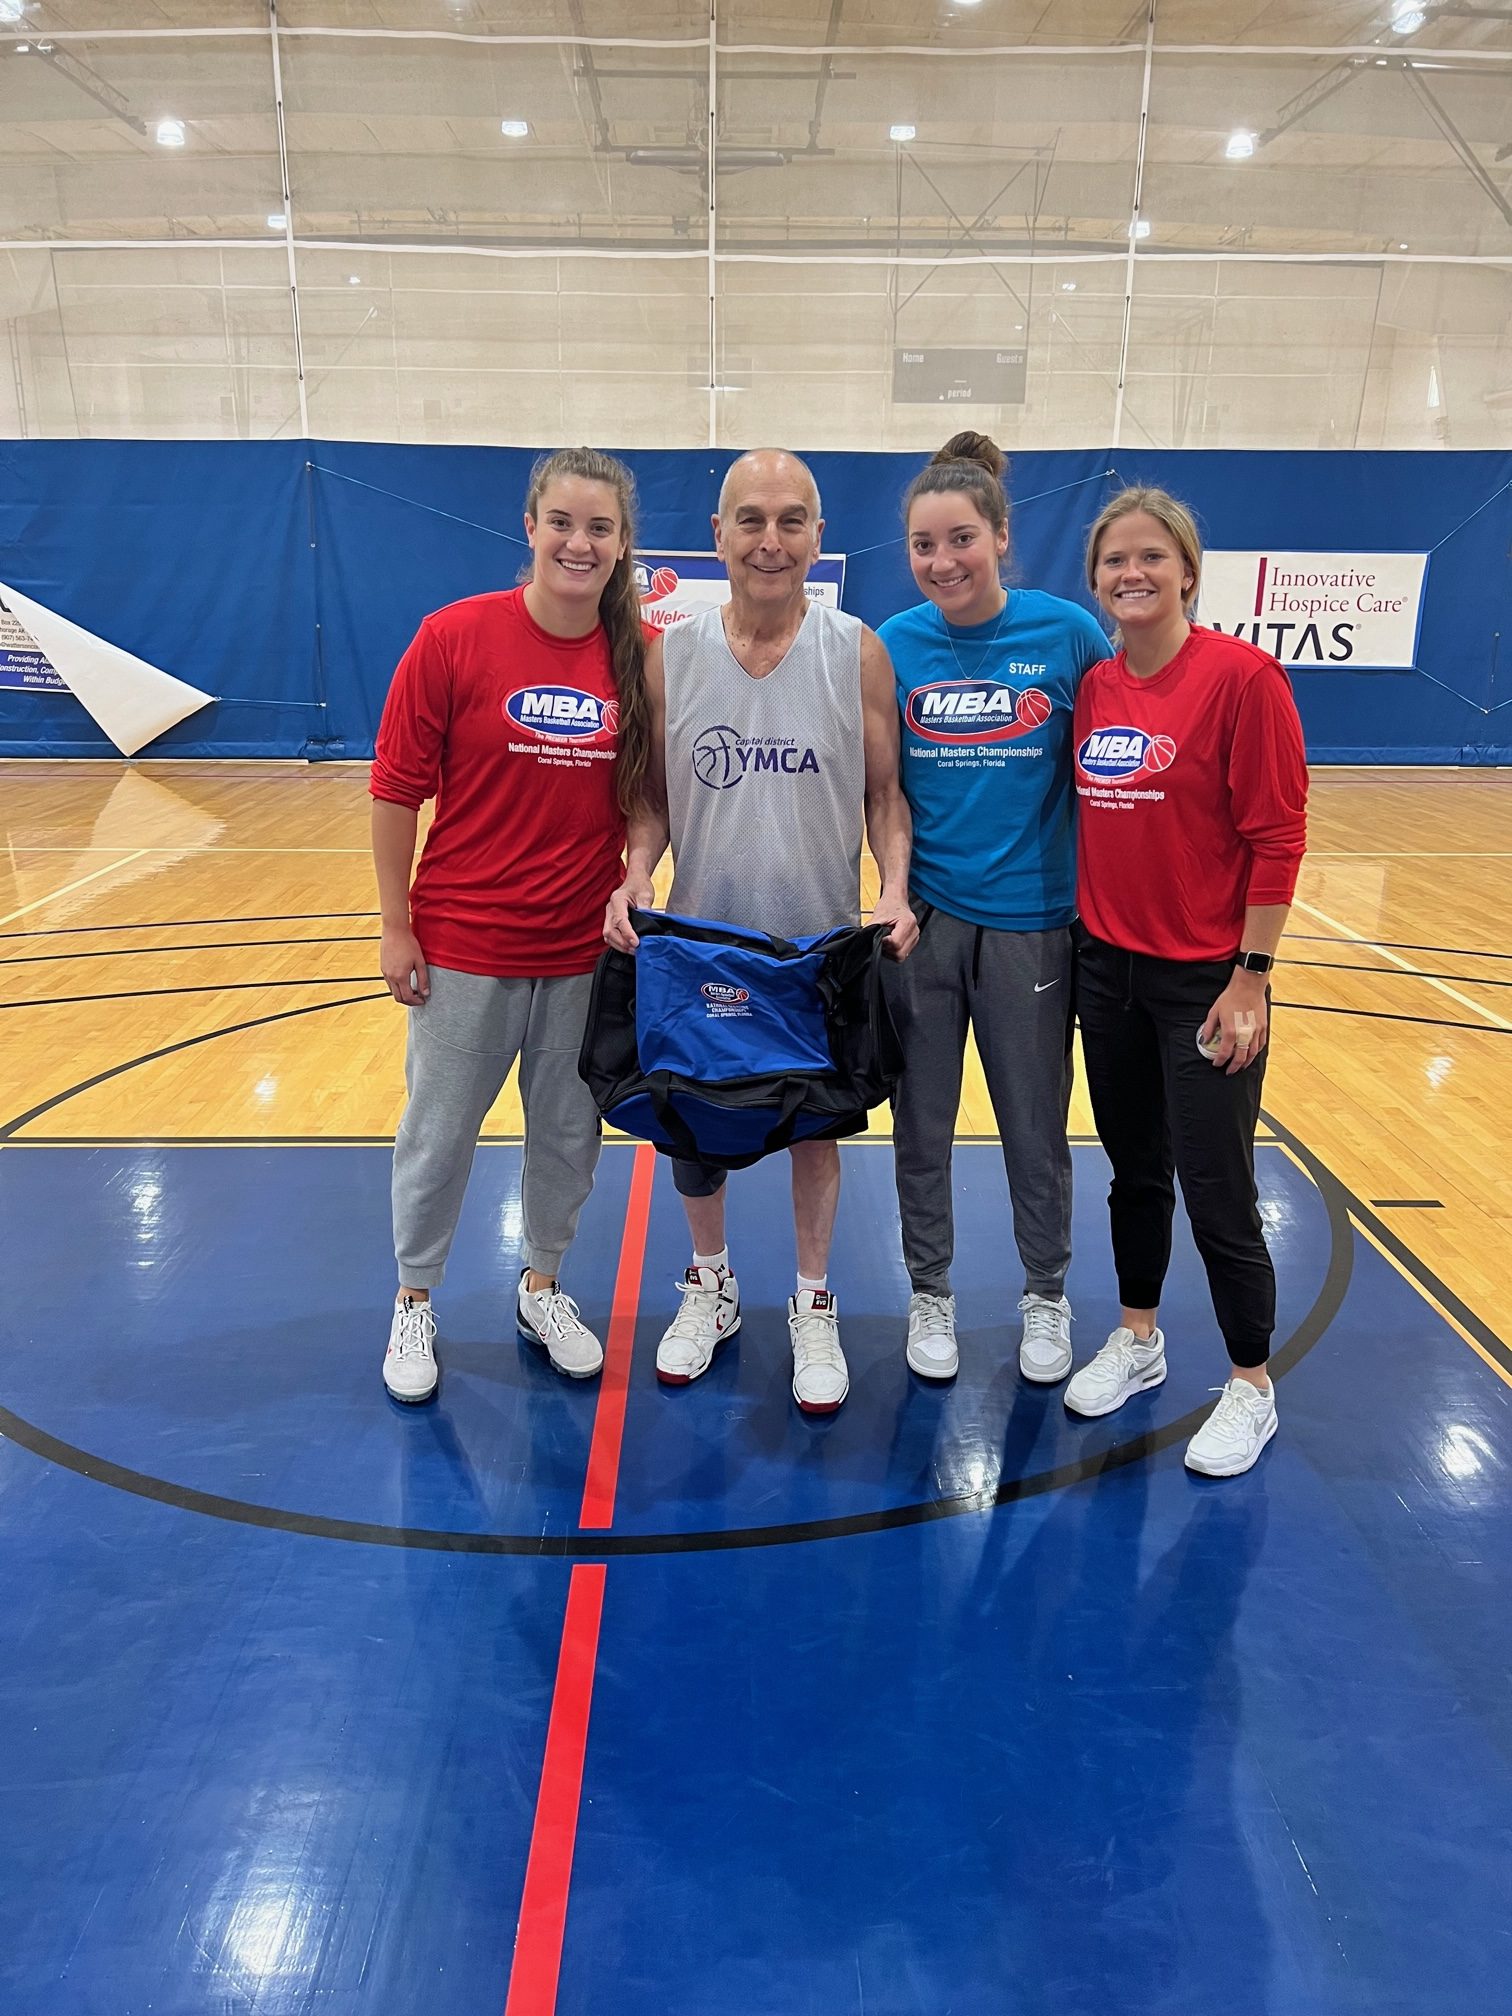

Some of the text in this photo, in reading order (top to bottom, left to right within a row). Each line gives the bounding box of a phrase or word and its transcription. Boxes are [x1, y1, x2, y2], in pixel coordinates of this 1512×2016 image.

[903, 352, 924, 363] Home
[947, 388, 972, 399] period
[1271, 567, 1376, 587] Innovative
[1269, 592, 1350, 618] Hospice
[8, 654, 39, 665] Providing
[0, 664, 39, 674] onstruction,
[1009, 663, 1047, 675] STAFF
[24, 675, 45, 683] Within
[521, 692, 599, 721] MBA
[922, 689, 1012, 715] MBA
[920, 714, 1012, 724] Masters Basketball Association
[764, 737, 795, 746] district
[1085, 735, 1144, 759] MBA
[508, 742, 540, 754] National
[541, 744, 571, 757] Masters
[910, 746, 1043, 759] National Masters Championships
[537, 756, 552, 766] Coral
[735, 747, 820, 773] YMCA
[955, 759, 982, 768] Springs,
[983, 759, 1005, 767] Florida
[1115, 789, 1165, 802] Championships
[708, 986, 735, 994] MBA
